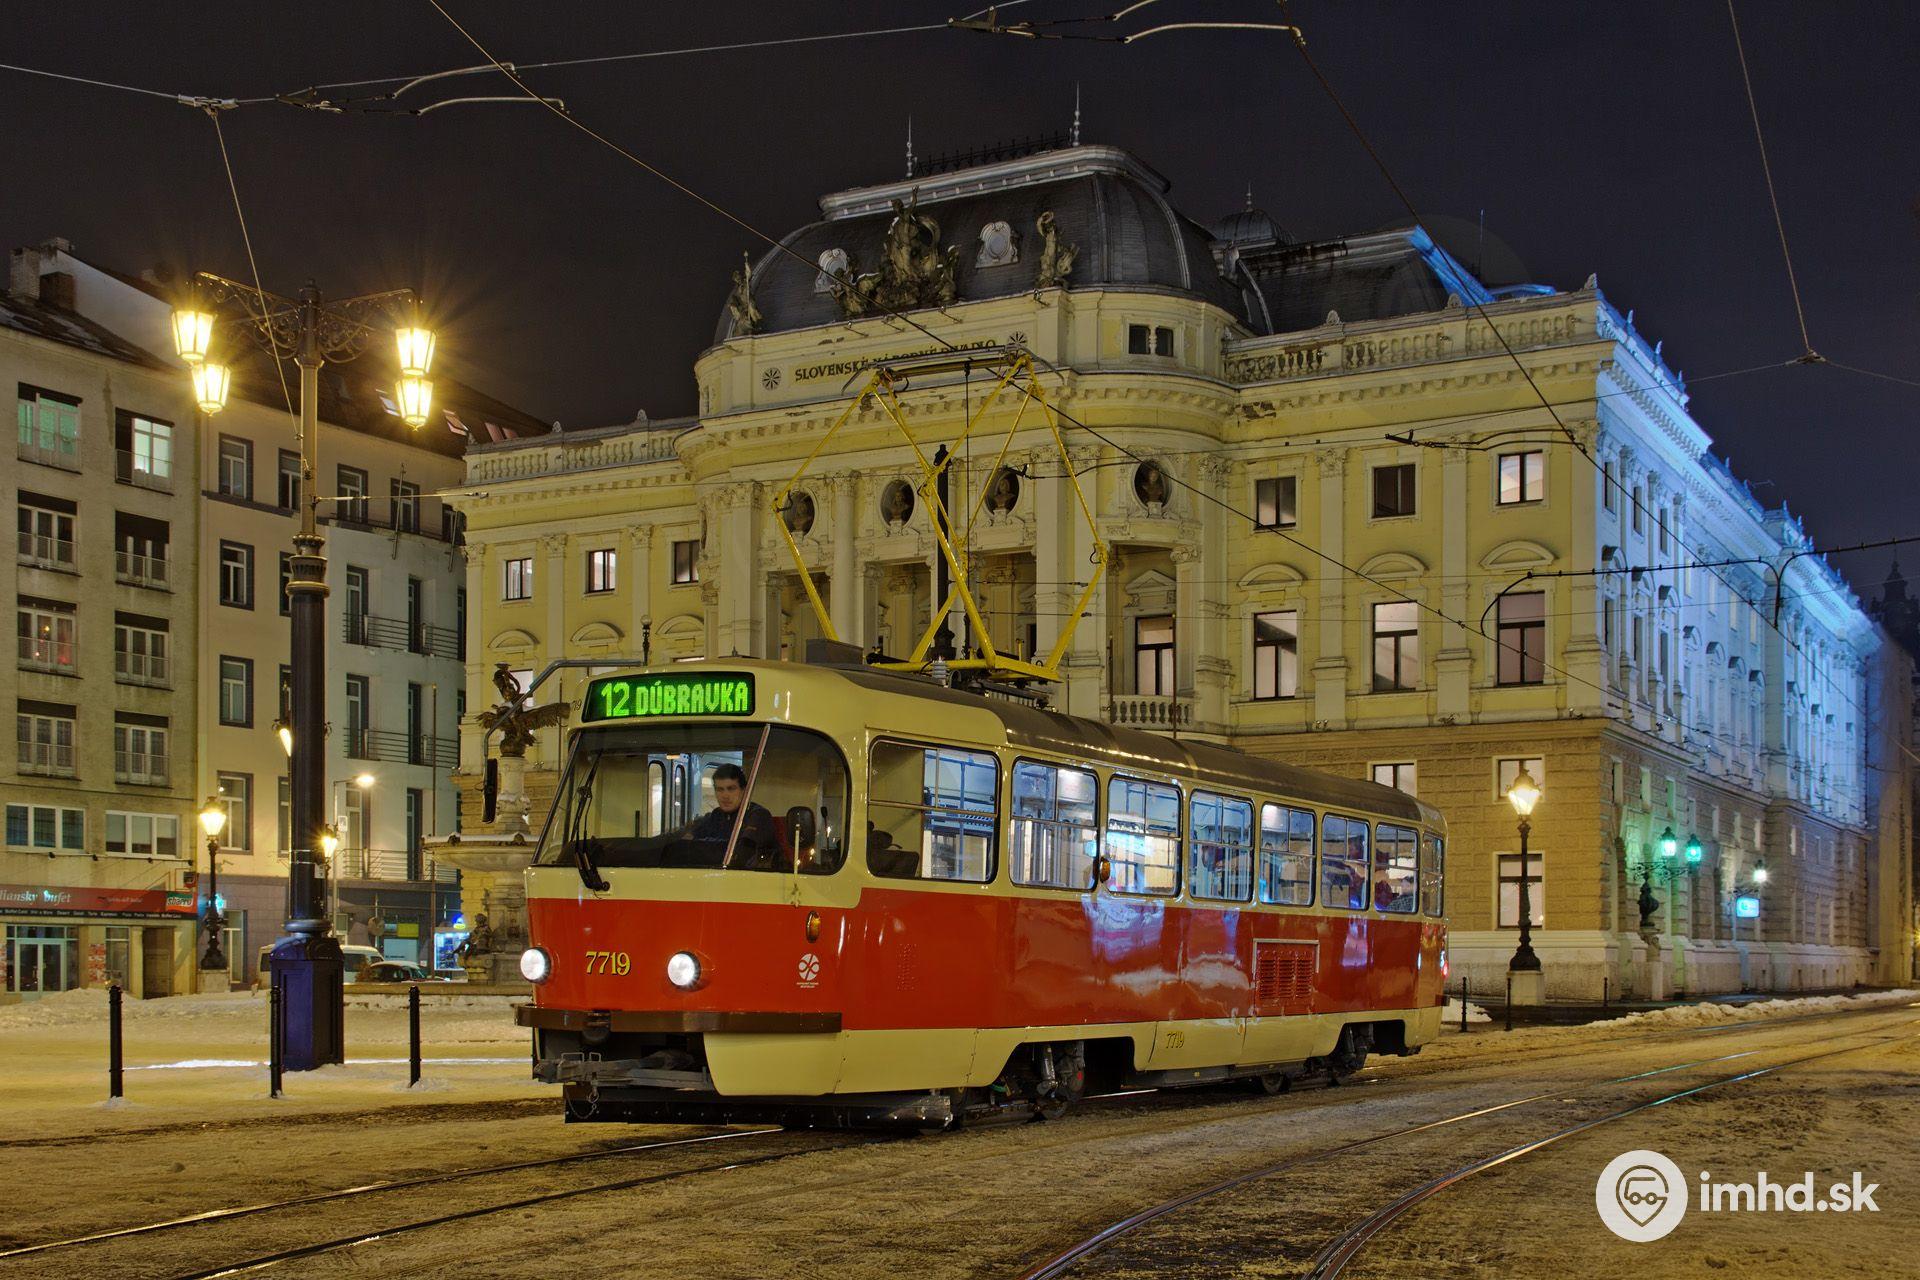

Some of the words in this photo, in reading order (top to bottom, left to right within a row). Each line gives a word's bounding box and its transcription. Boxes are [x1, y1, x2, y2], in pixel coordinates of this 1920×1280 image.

[601, 682, 630, 717] 12
[636, 680, 749, 715] DÚBRAVKA
[585, 951, 631, 976] 7719
[1166, 1031, 1185, 1049] 7719
